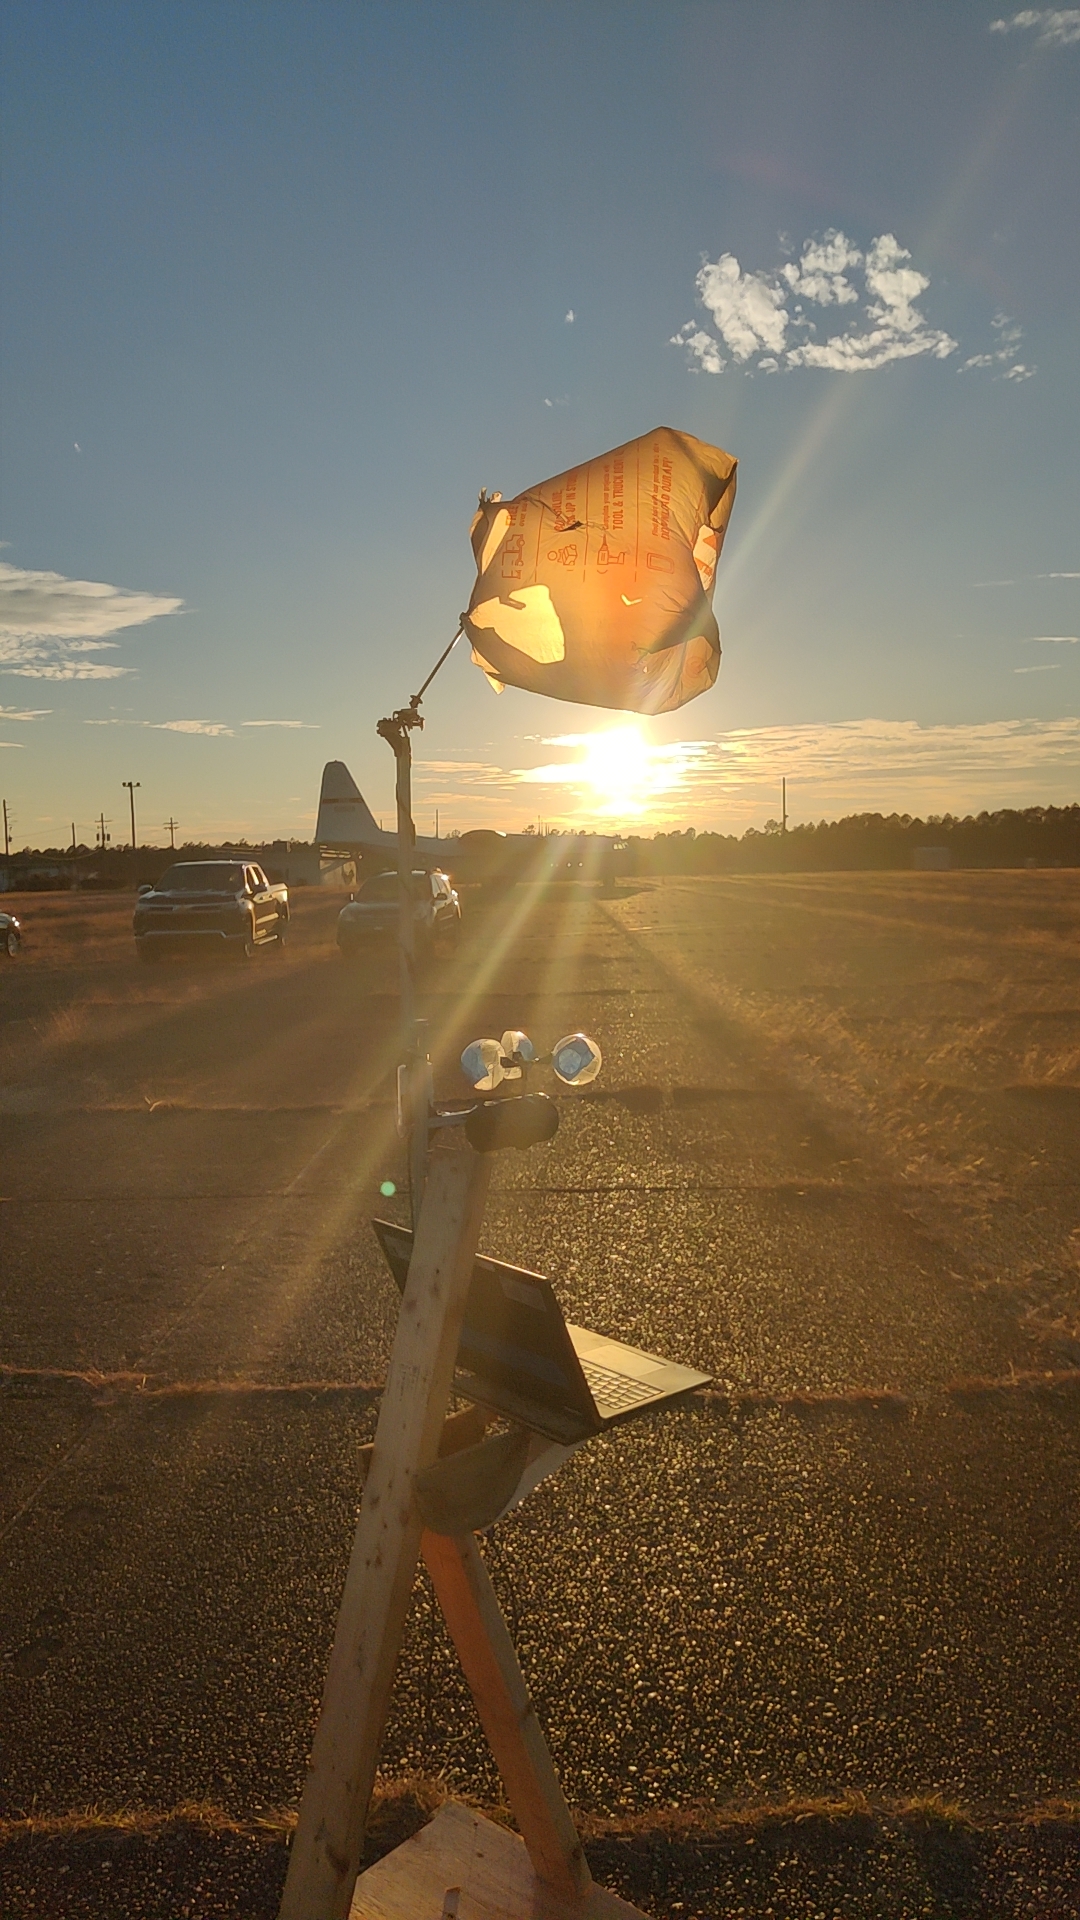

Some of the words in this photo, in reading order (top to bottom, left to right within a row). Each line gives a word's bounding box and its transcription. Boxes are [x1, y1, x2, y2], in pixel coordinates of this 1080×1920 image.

[613, 475, 623, 499] TRUCK
[661, 475, 672, 492] OUR
[565, 502, 576, 512] UP
[612, 510, 623, 530] TOOL
